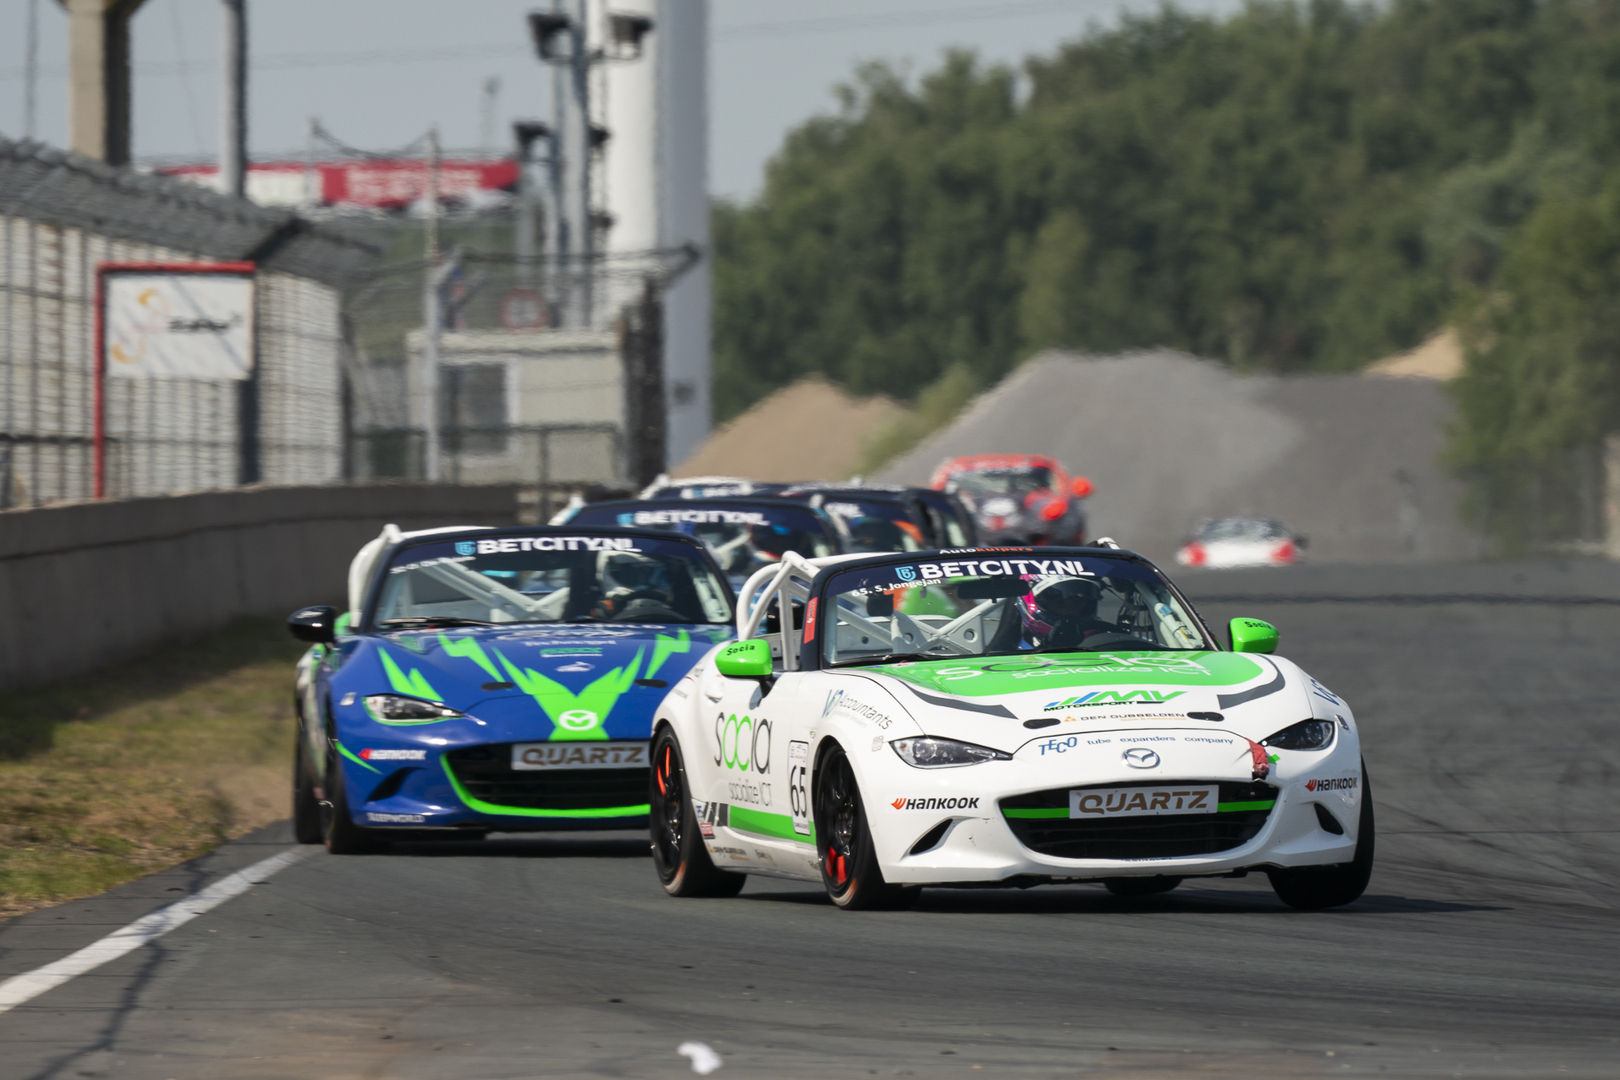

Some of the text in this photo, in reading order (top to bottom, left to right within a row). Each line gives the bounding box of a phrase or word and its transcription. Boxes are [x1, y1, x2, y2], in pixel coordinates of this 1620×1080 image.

[477, 538, 641, 554] BETCITY.NL
[918, 560, 1095, 580] BETCITY.NL
[851, 577, 941, 598] 65. S. Jongejan
[1244, 621, 1272, 630] Socia
[726, 644, 755, 656] Socia
[1012, 666, 1155, 678] socialize
[1043, 700, 1136, 712] MOTORSPORT
[1038, 735, 1234, 756] TECO tube expanders company
[521, 746, 646, 766] QUARTZ
[790, 764, 807, 818] 65
[905, 796, 980, 811] HANKOOK
[1078, 790, 1210, 816] QUARTZ
